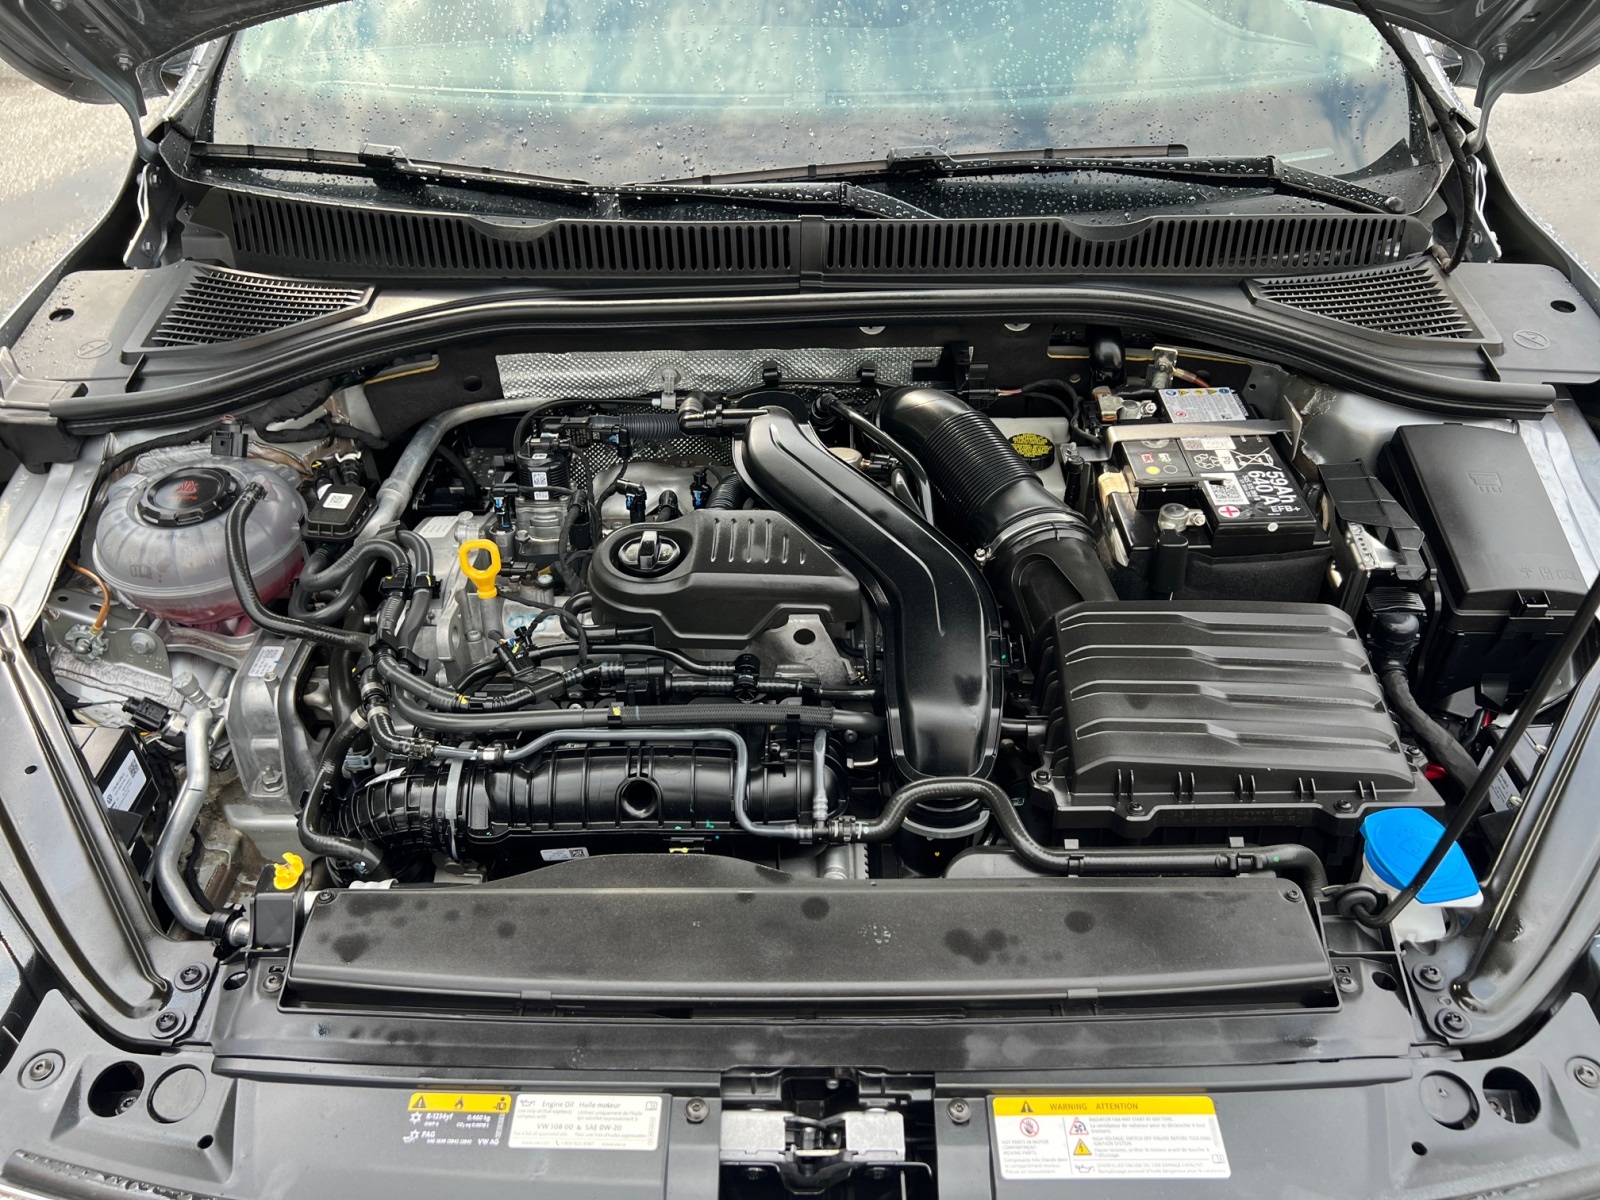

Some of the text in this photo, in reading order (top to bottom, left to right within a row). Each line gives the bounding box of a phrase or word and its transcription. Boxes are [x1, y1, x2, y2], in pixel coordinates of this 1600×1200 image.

[1248, 470, 1274, 492] 640
[1266, 471, 1297, 503] 59Ah
[1260, 495, 1280, 505] A
